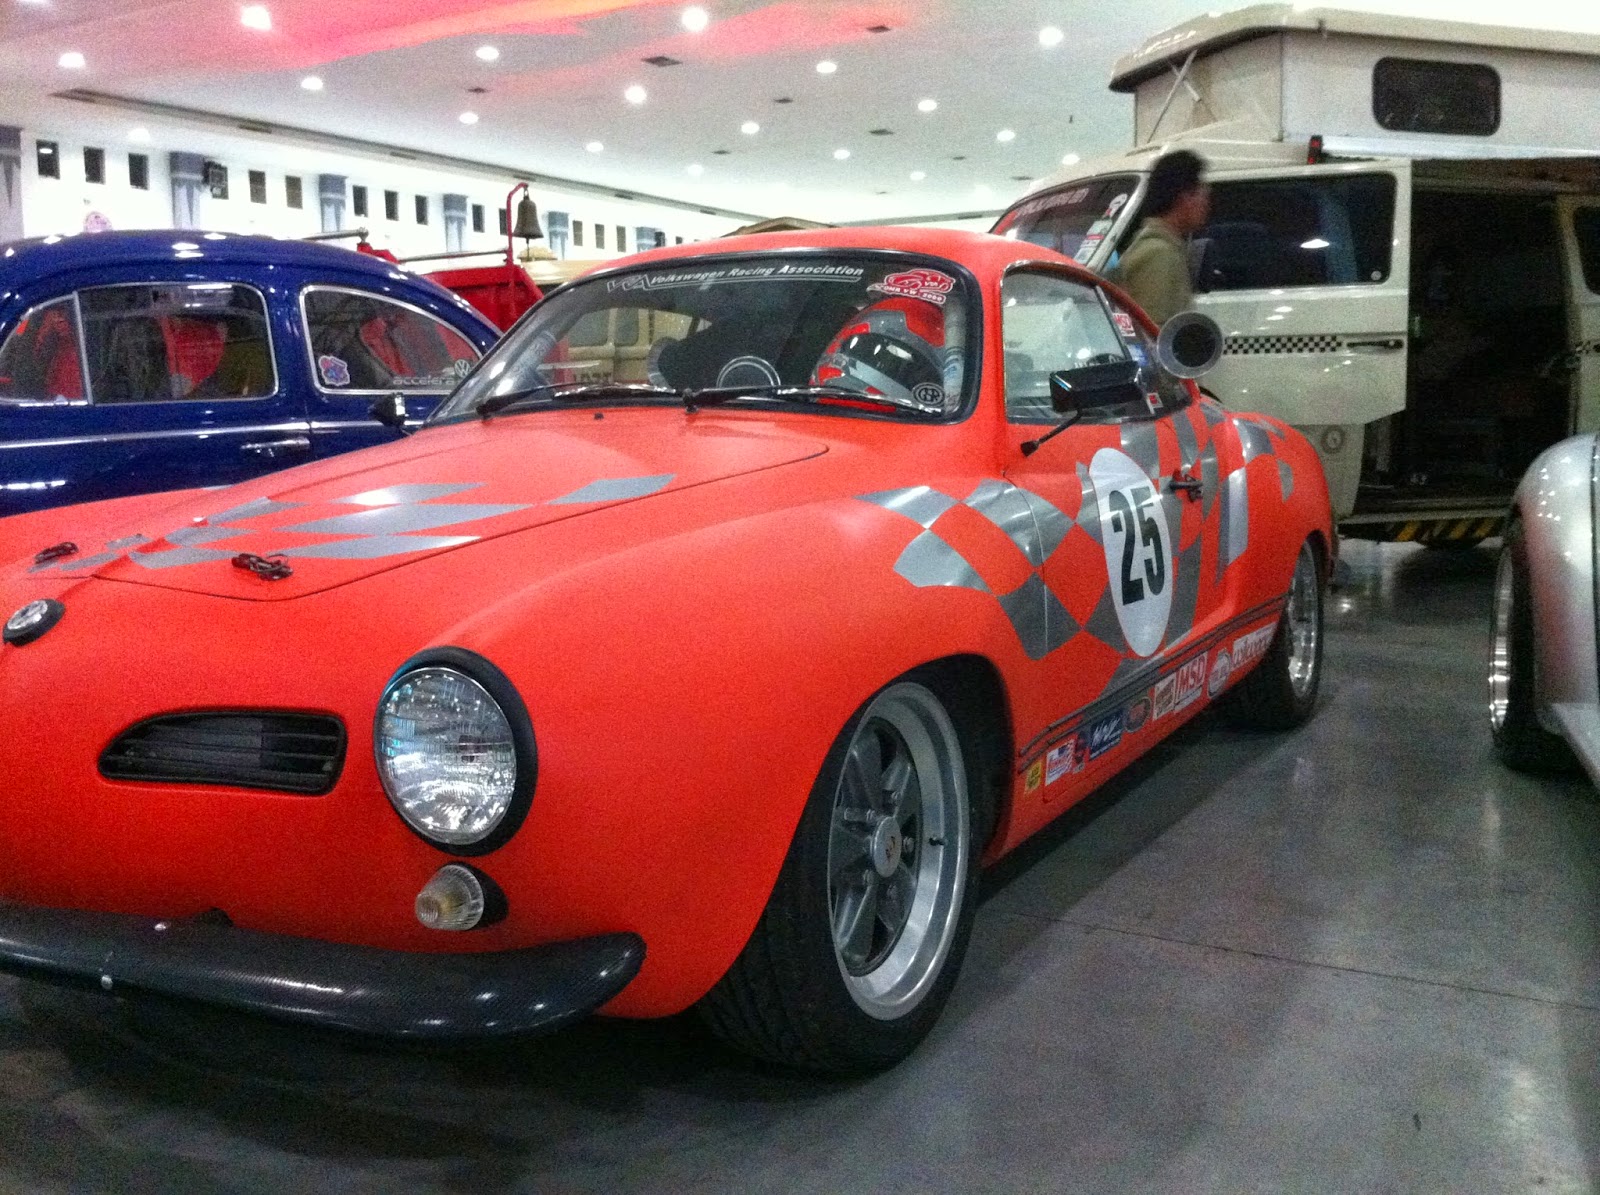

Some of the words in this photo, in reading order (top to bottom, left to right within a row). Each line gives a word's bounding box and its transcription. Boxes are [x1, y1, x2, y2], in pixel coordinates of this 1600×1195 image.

[651, 270, 725, 284] Volkswagen
[727, 266, 776, 277] Racing
[777, 264, 865, 276] Association
[1108, 486, 1165, 606] 25
